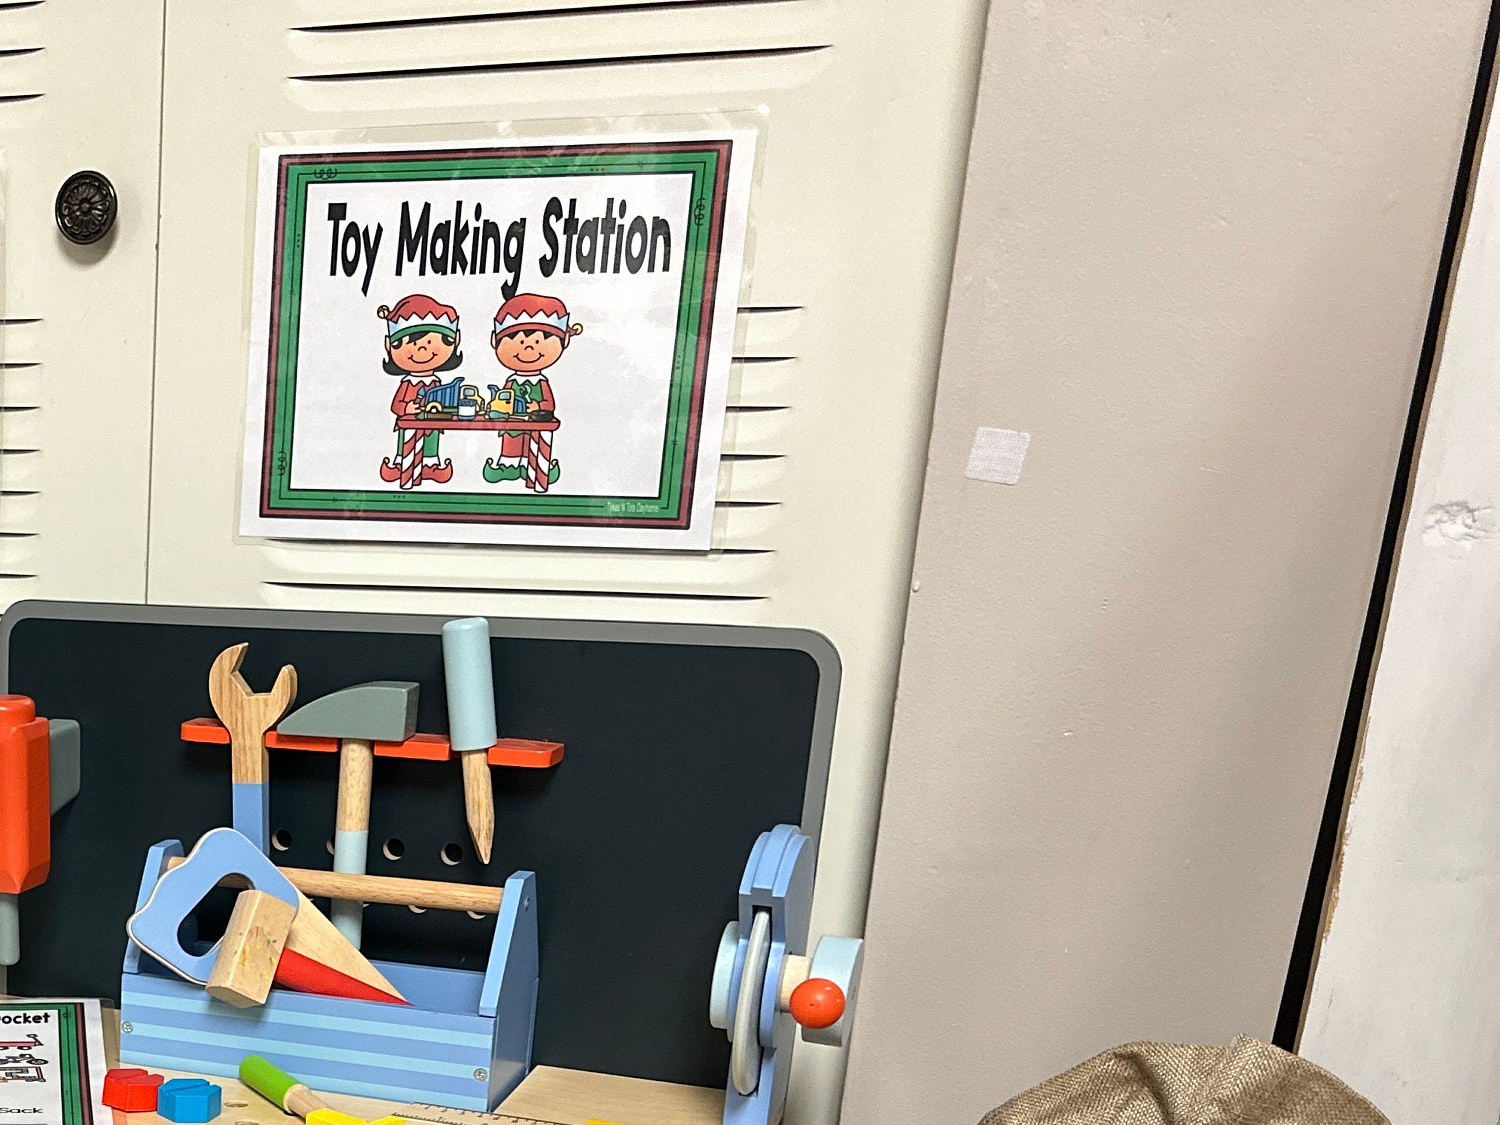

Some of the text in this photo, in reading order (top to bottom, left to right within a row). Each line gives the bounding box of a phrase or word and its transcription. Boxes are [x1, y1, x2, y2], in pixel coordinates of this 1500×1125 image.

[327, 196, 672, 301] Toy Making Station
